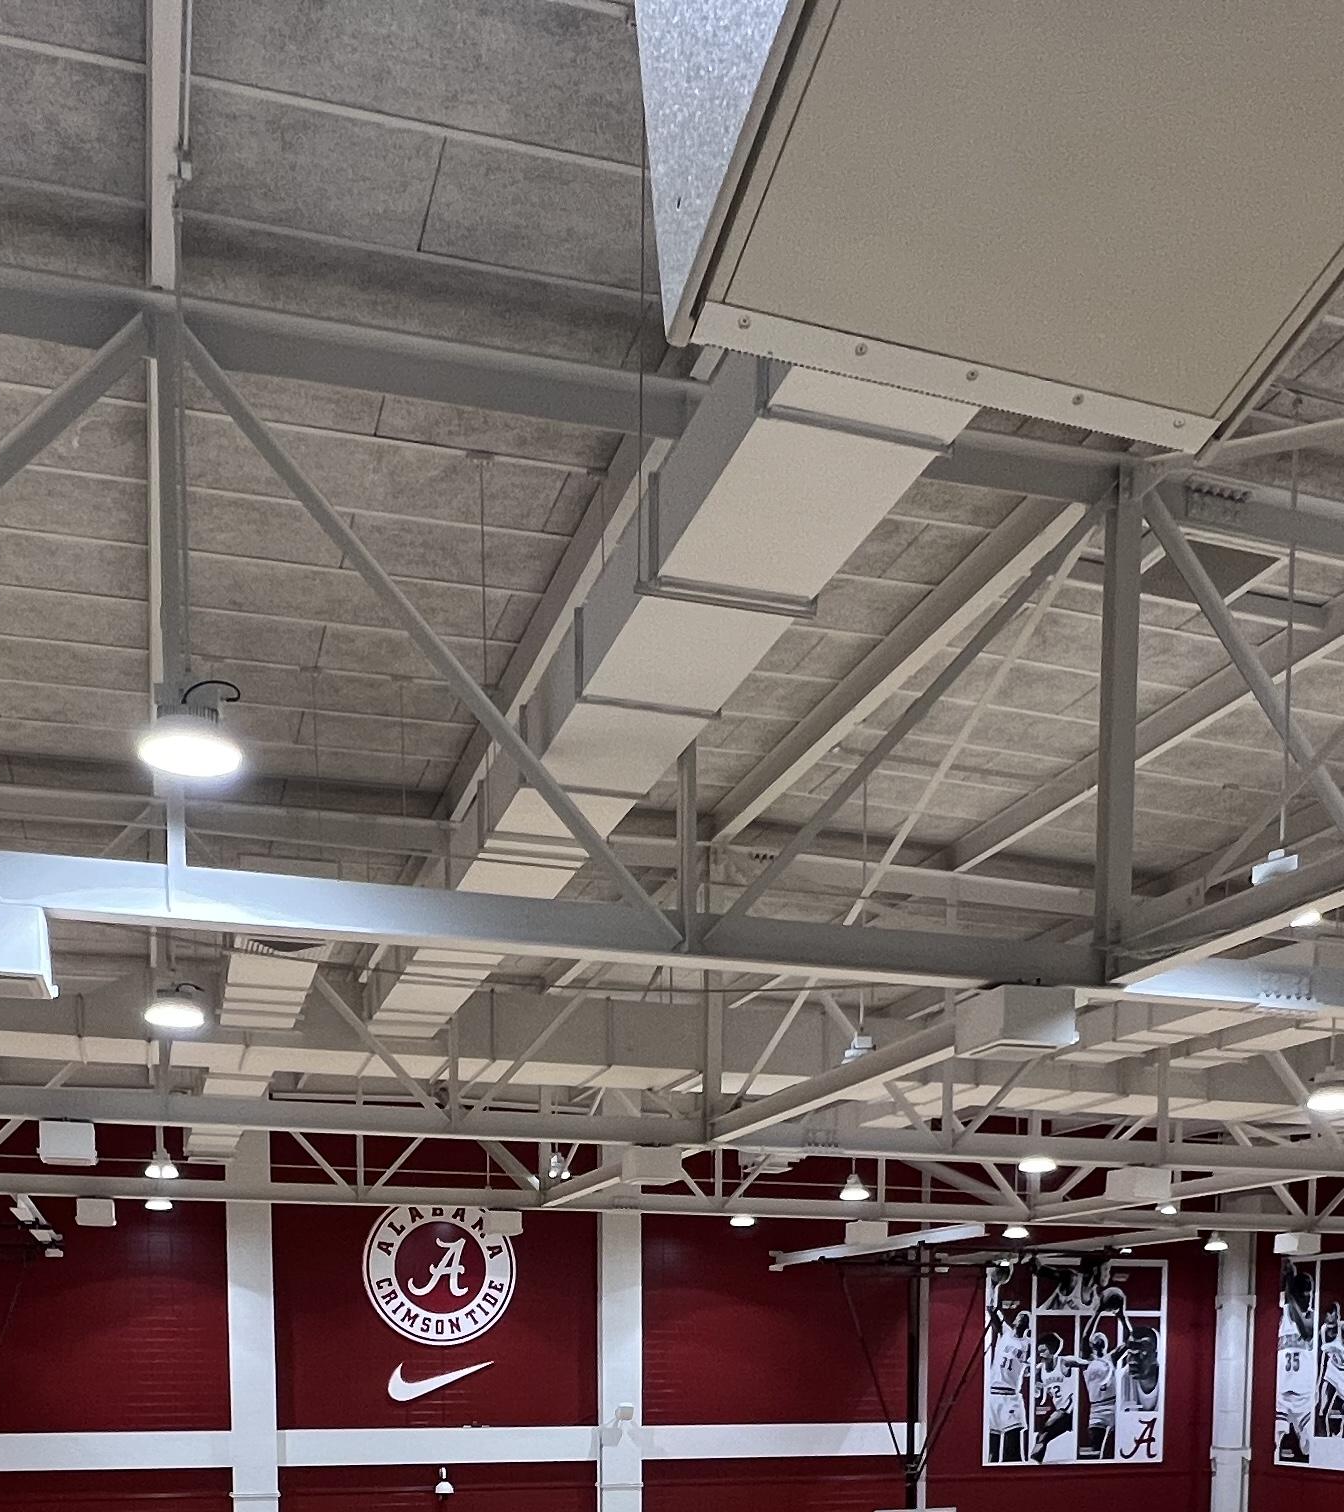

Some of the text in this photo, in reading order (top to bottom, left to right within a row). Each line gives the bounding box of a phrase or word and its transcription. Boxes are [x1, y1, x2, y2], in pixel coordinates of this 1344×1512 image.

[408, 1237, 469, 1297] A
[376, 1277, 505, 1335] CRIMSON TIDE
[1284, 1352, 1300, 1372] 35
[1119, 1418, 1158, 1459] A
